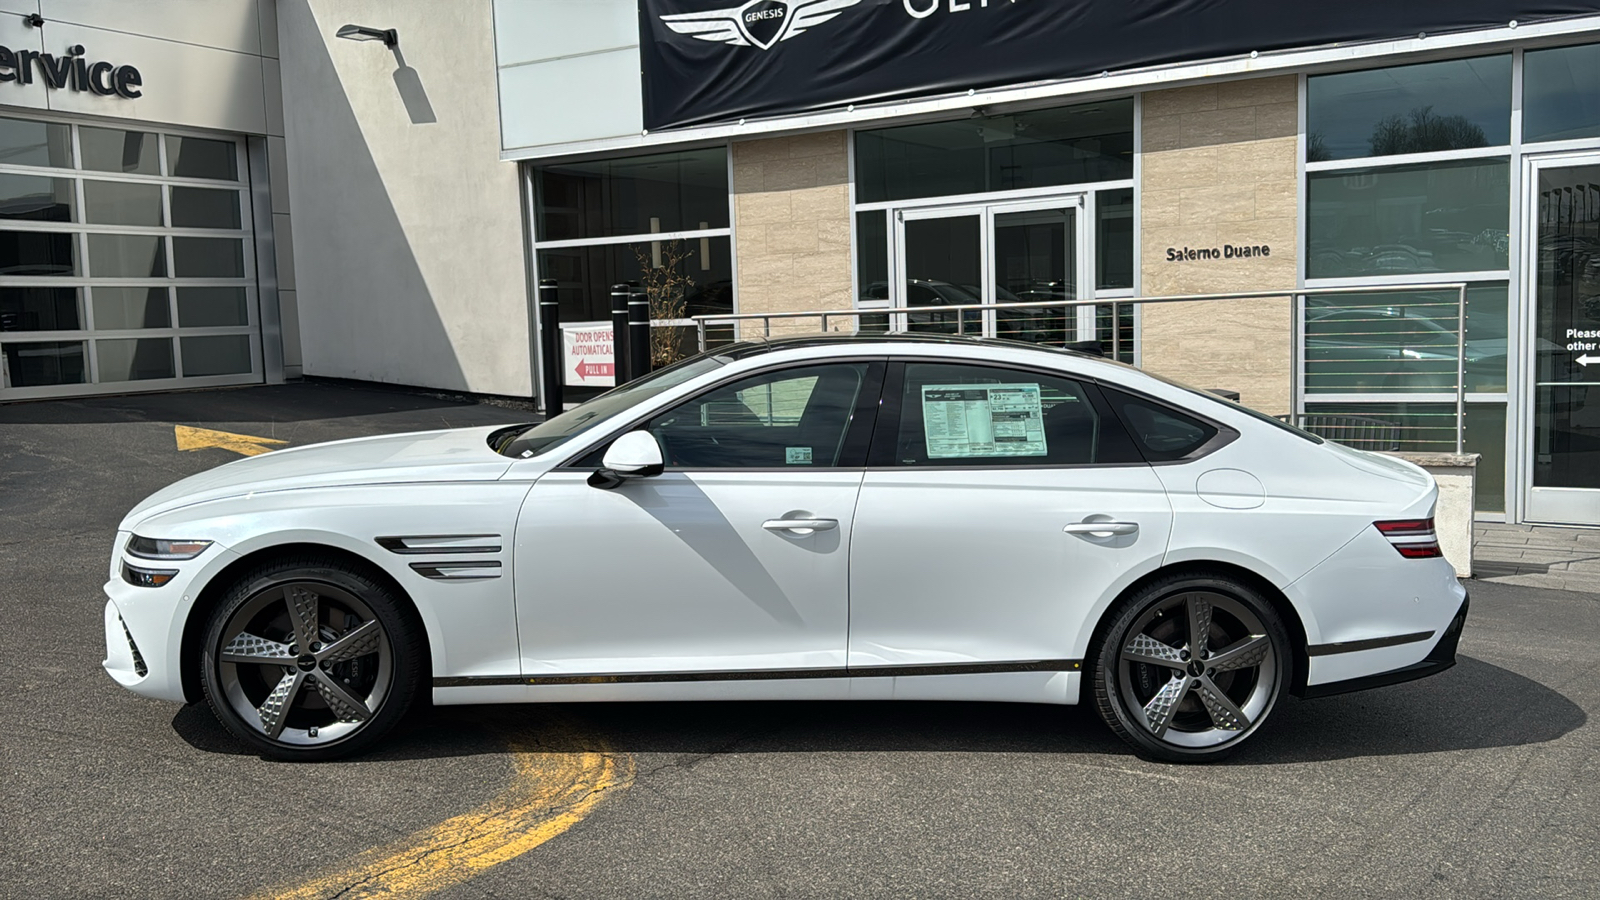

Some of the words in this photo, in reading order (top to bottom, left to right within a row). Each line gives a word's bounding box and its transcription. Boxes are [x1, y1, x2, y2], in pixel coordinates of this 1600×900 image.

[745, 8, 784, 22] GENESIS
[1166, 247, 1220, 261] Salerno
[1224, 245, 1271, 259] Duane
[575, 332, 593, 343] DOOR
[594, 331, 614, 342] OPENS
[572, 345, 613, 355] AUTOMATICAL
[1566, 341, 1597, 351] other
[585, 365, 599, 374] PULL
[601, 365, 608, 374] IN
